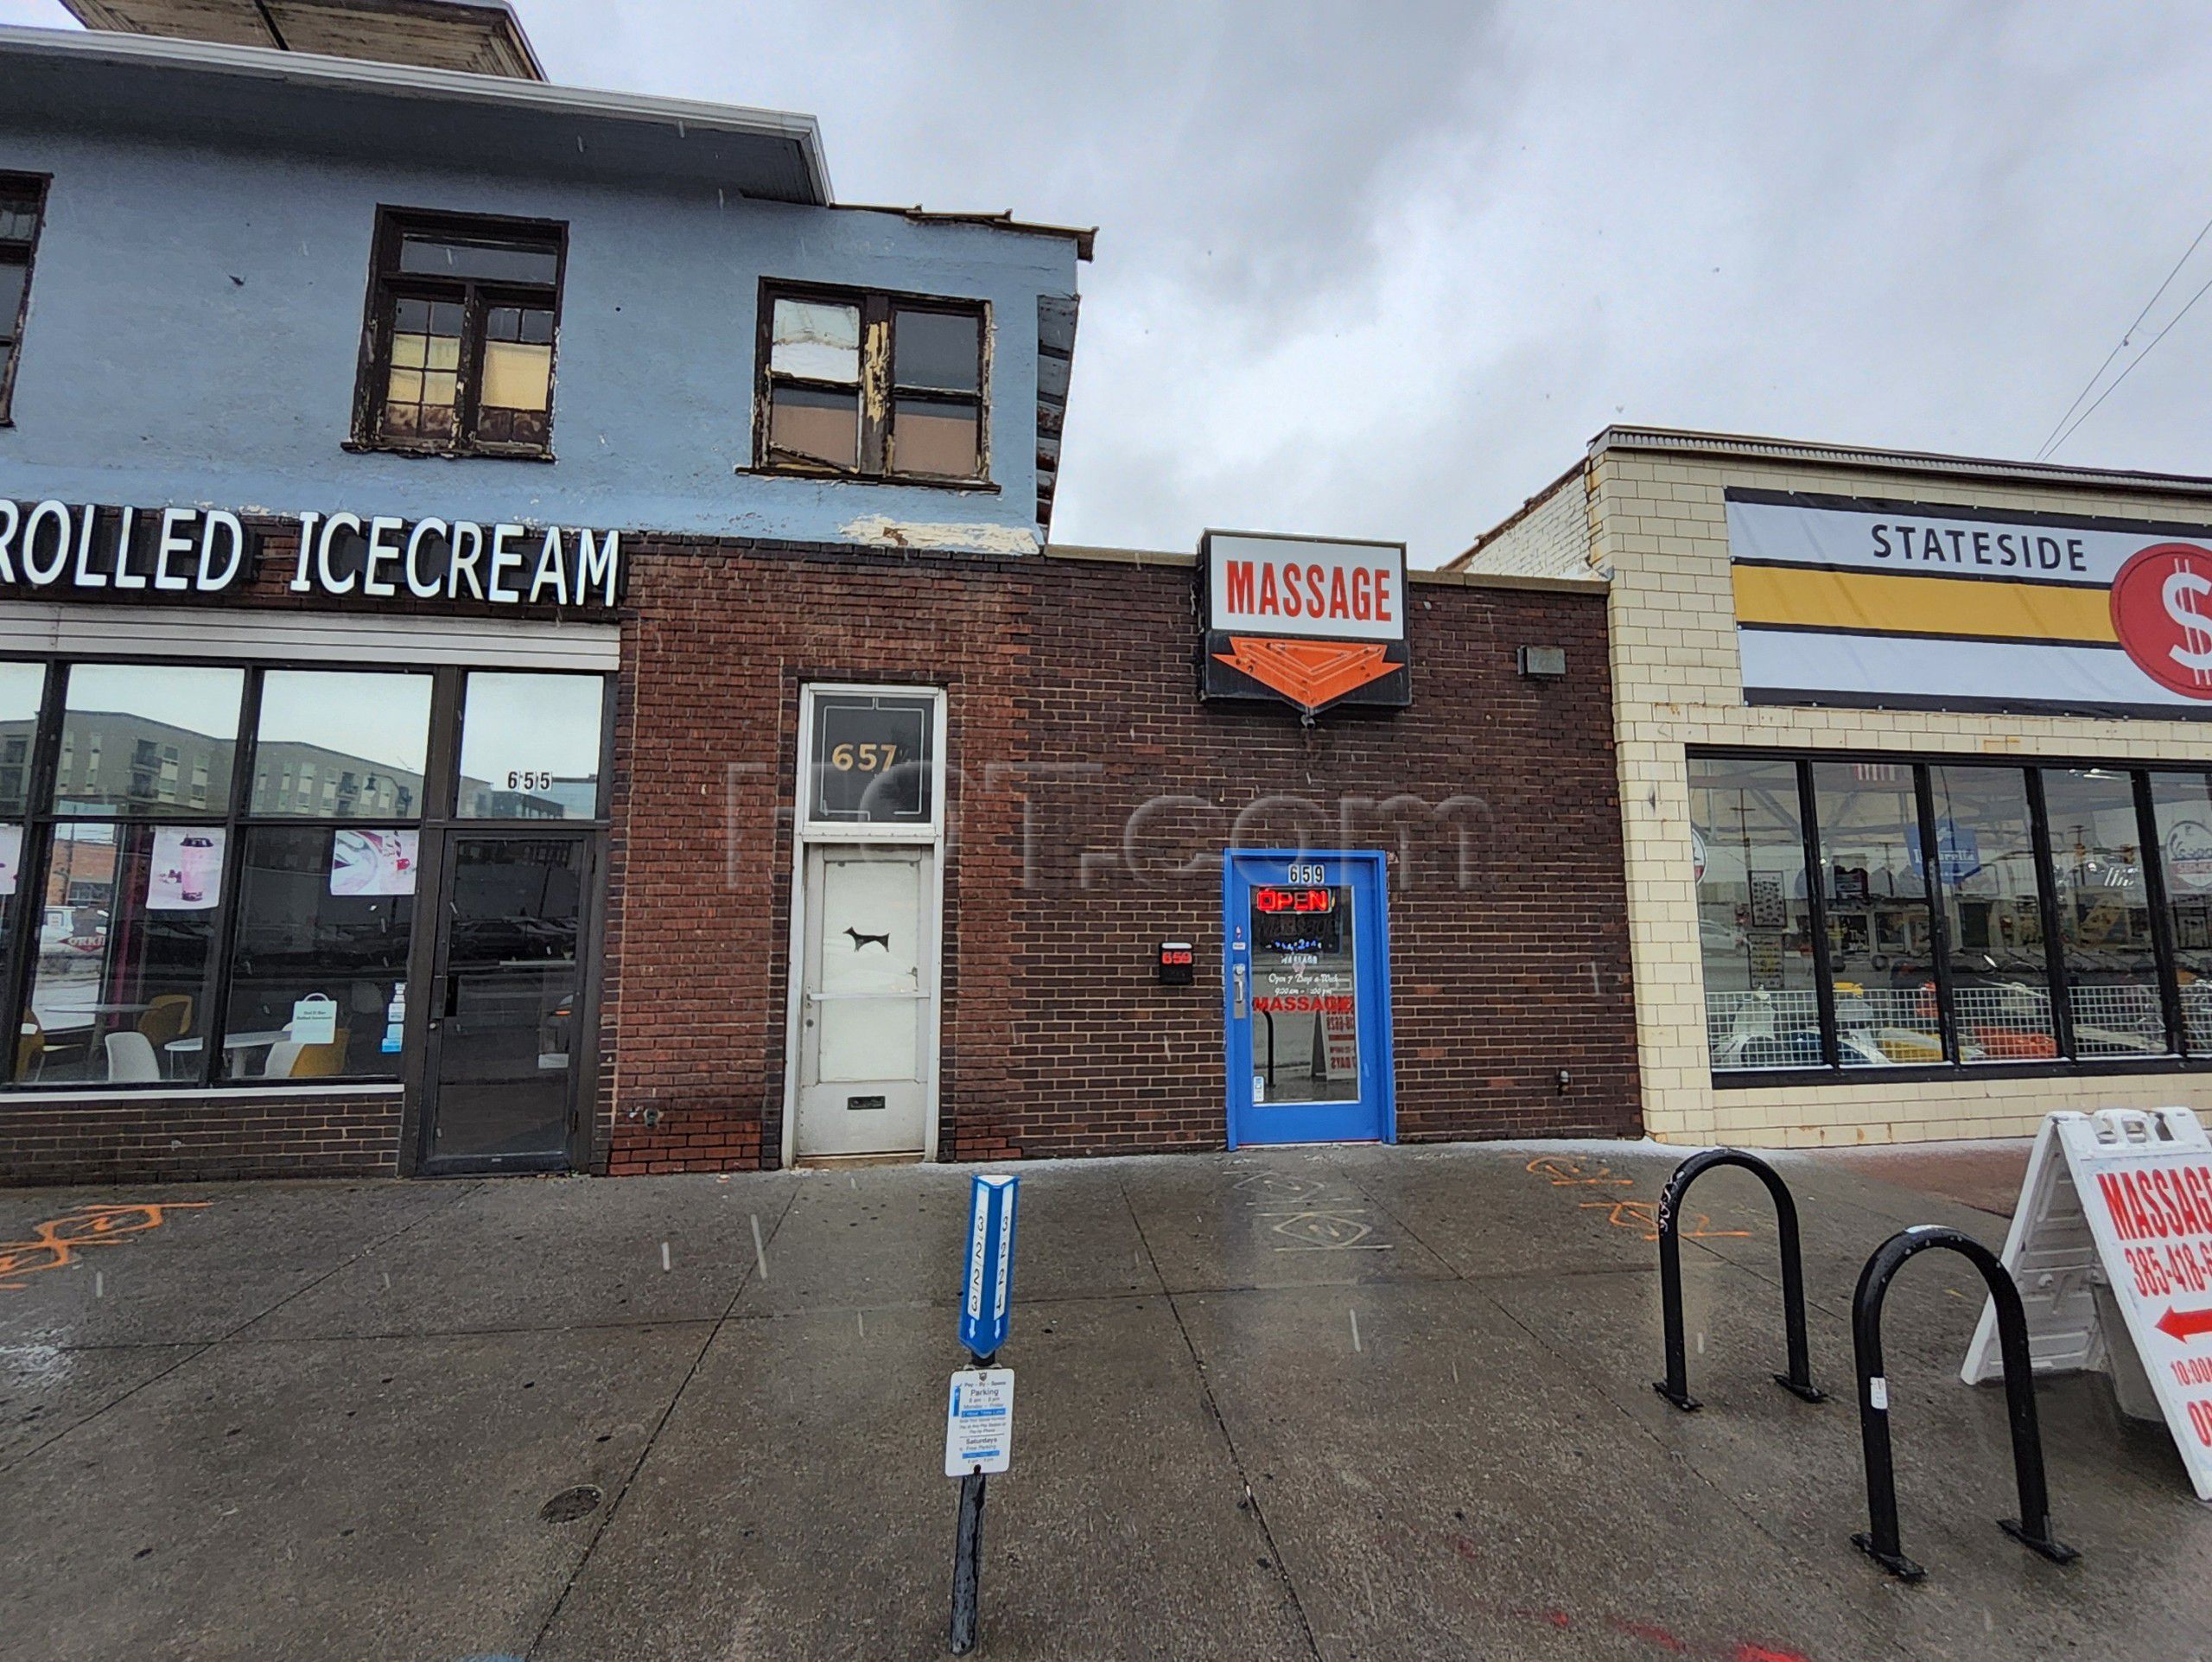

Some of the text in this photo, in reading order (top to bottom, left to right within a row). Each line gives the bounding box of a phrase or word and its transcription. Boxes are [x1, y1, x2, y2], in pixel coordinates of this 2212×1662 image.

[1872, 523, 2088, 572] STATESIDE
[290, 512, 620, 606] ICECREAM
[1227, 560, 1391, 622] MASSAGE
[831, 743, 898, 772] 657
[507, 771, 550, 790] 655
[1290, 865, 1323, 882] 659
[1257, 890, 1328, 911] OPEN
[1162, 952, 1192, 964] 659
[1268, 973, 1286, 984] Open
[1252, 996, 1351, 1011] MASSAGE
